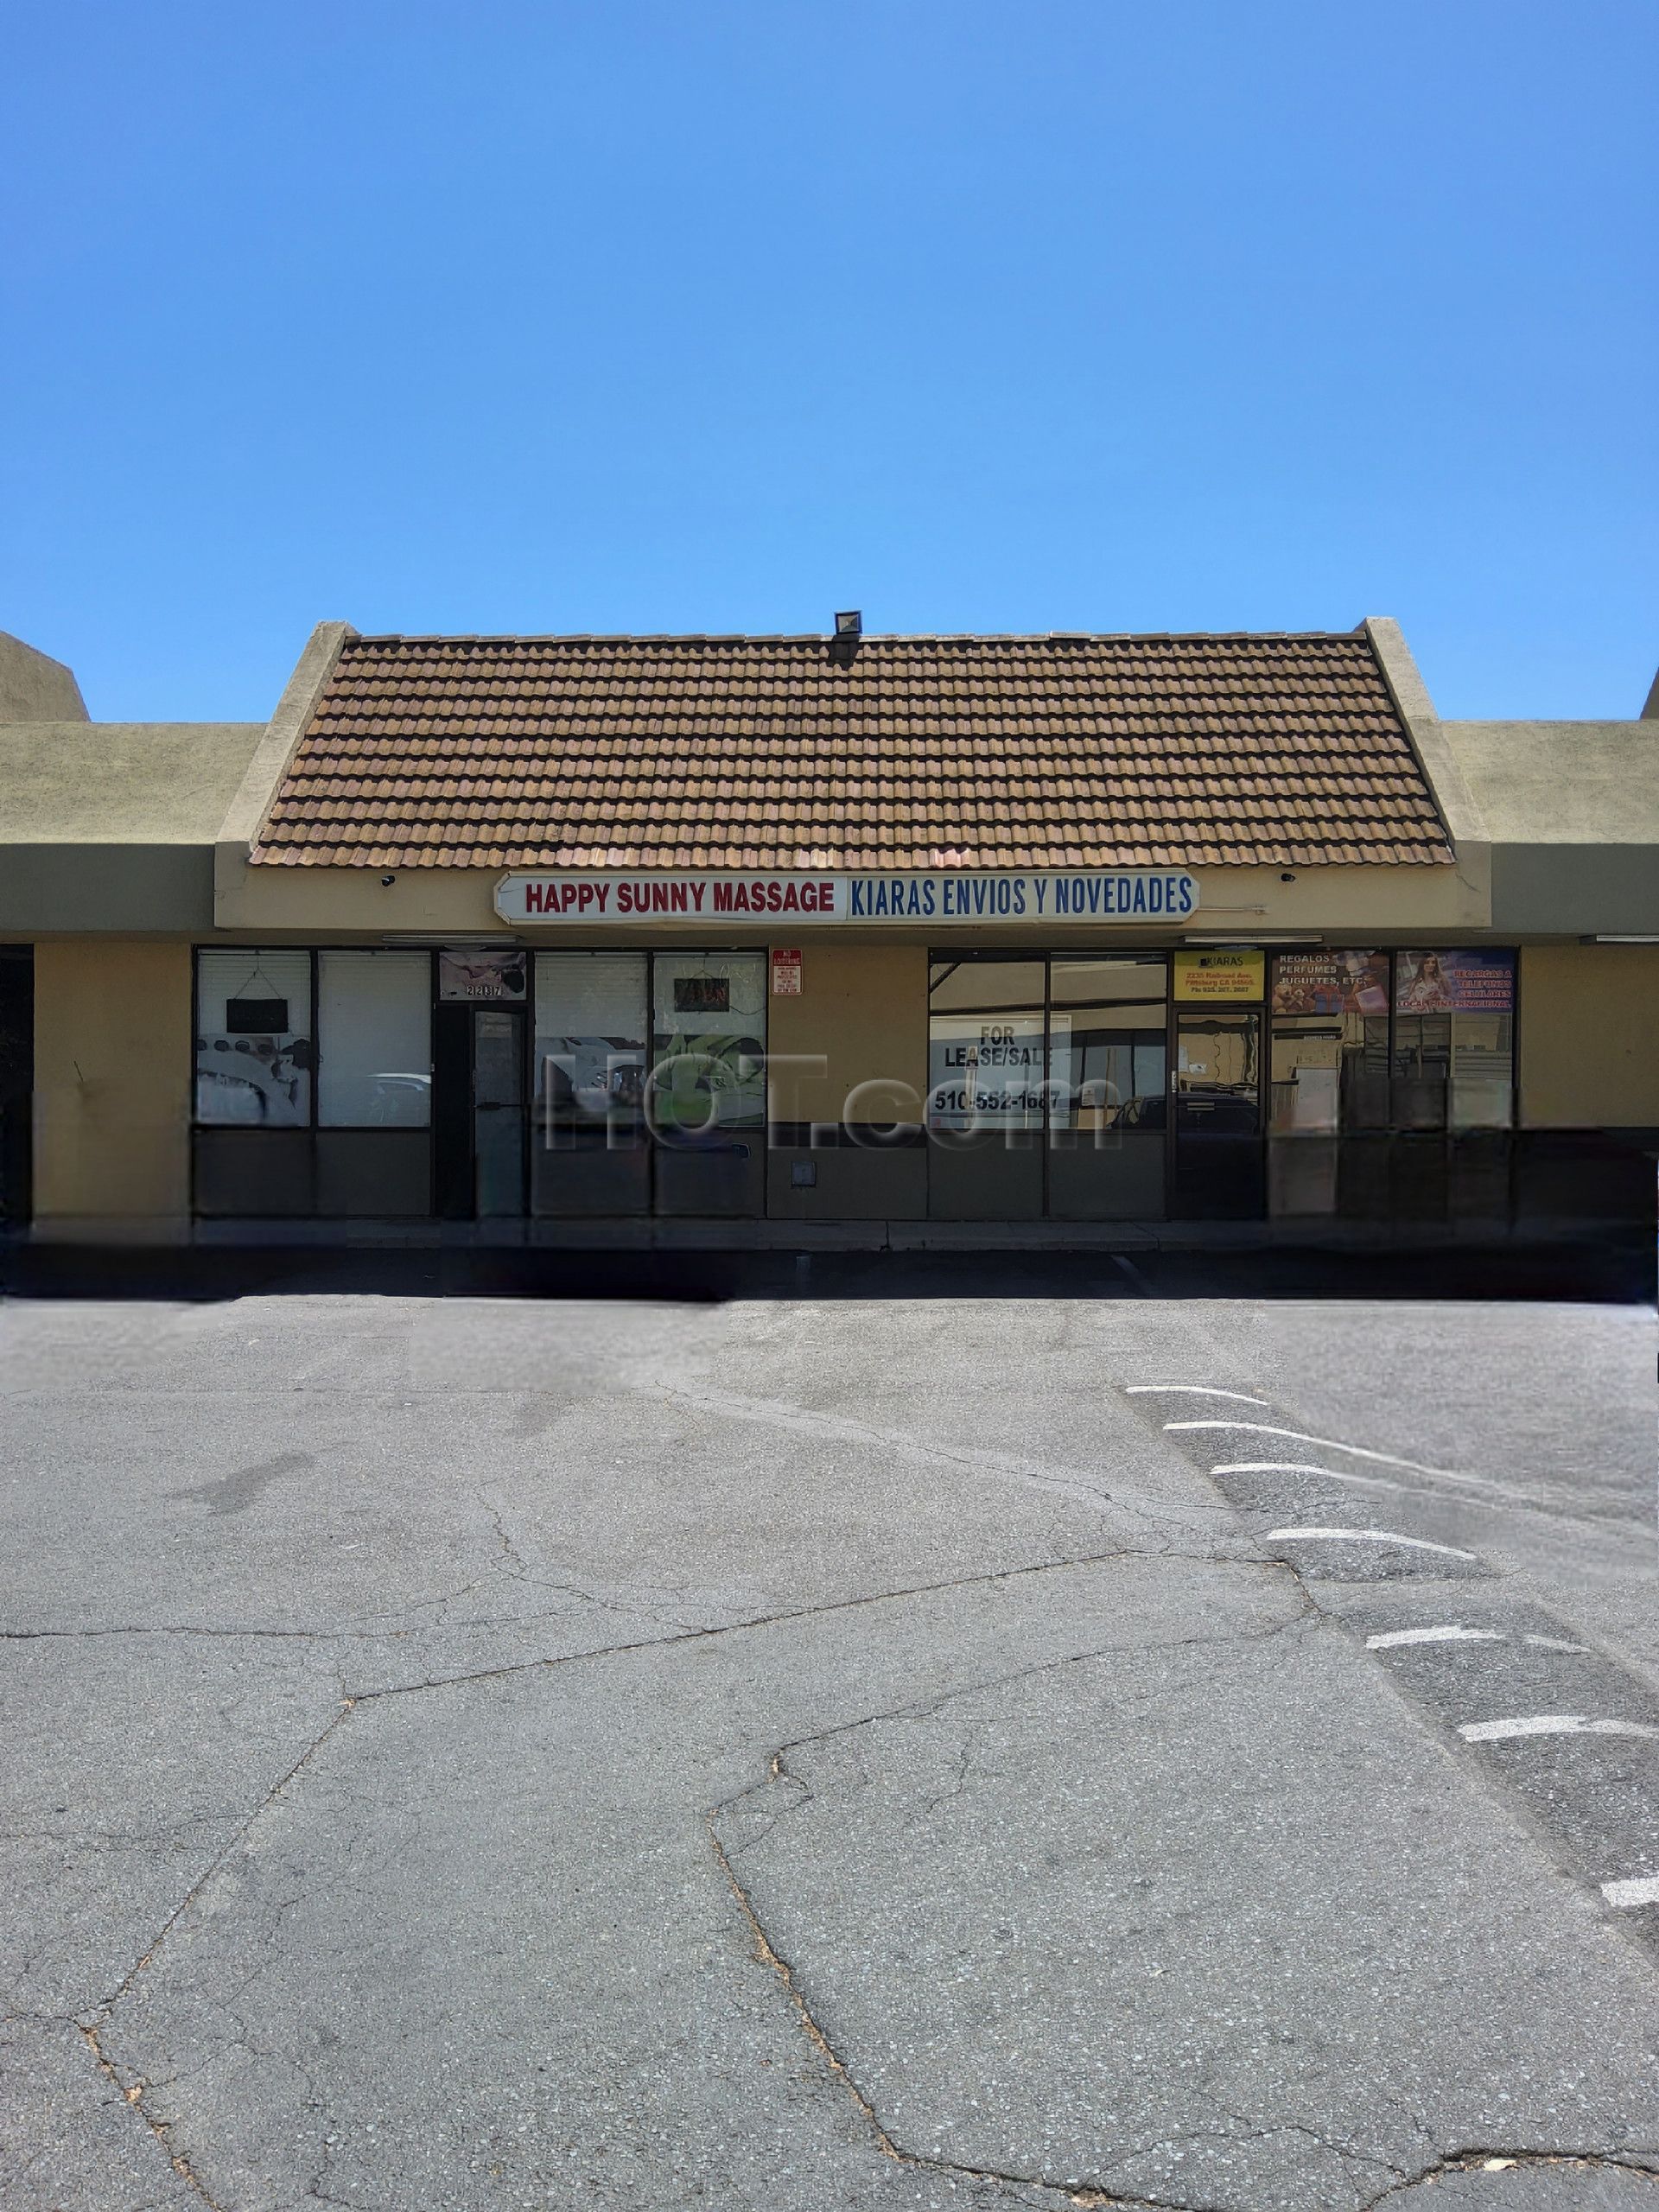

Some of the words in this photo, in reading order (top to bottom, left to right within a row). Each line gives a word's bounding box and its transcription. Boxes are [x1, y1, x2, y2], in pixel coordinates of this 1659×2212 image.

[526, 883, 610, 913] HAPPY
[617, 882, 707, 912] SUNNY
[714, 881, 835, 912] MASSAGE
[851, 879, 935, 916] KIARAS
[943, 878, 1027, 915] ENVIOS
[1035, 878, 1048, 914] Y
[1055, 876, 1192, 914] NOVEDADES
[1207, 956, 1244, 966] KIARAS
[1279, 955, 1330, 963] REGALOS
[1279, 965, 1338, 974] PERFUMES
[980, 1026, 1015, 1046] FOR
